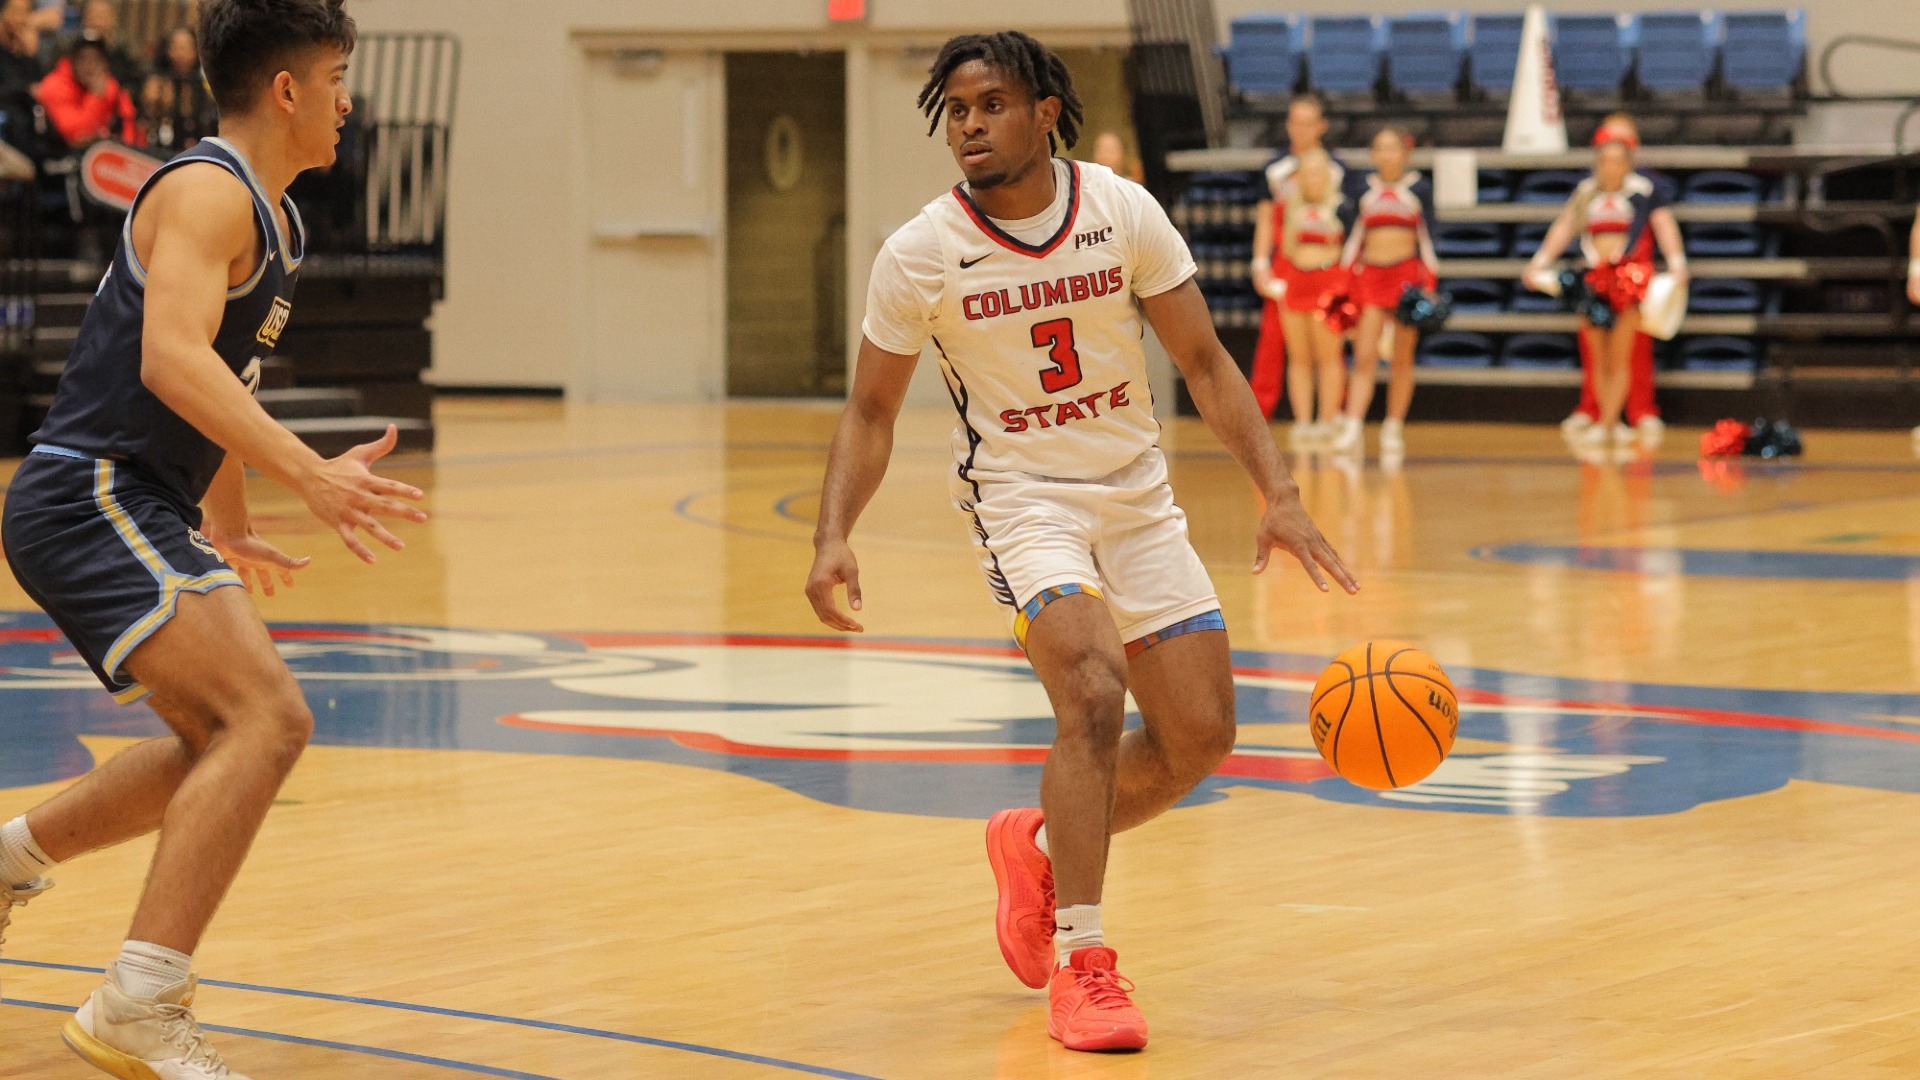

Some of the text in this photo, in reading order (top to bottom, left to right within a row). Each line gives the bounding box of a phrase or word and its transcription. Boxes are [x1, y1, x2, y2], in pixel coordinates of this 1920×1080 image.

[1074, 226, 1113, 250] PBC
[962, 266, 1124, 321] COLUMBUS
[1030, 317, 1083, 394] 3
[999, 381, 1131, 432] STATE
